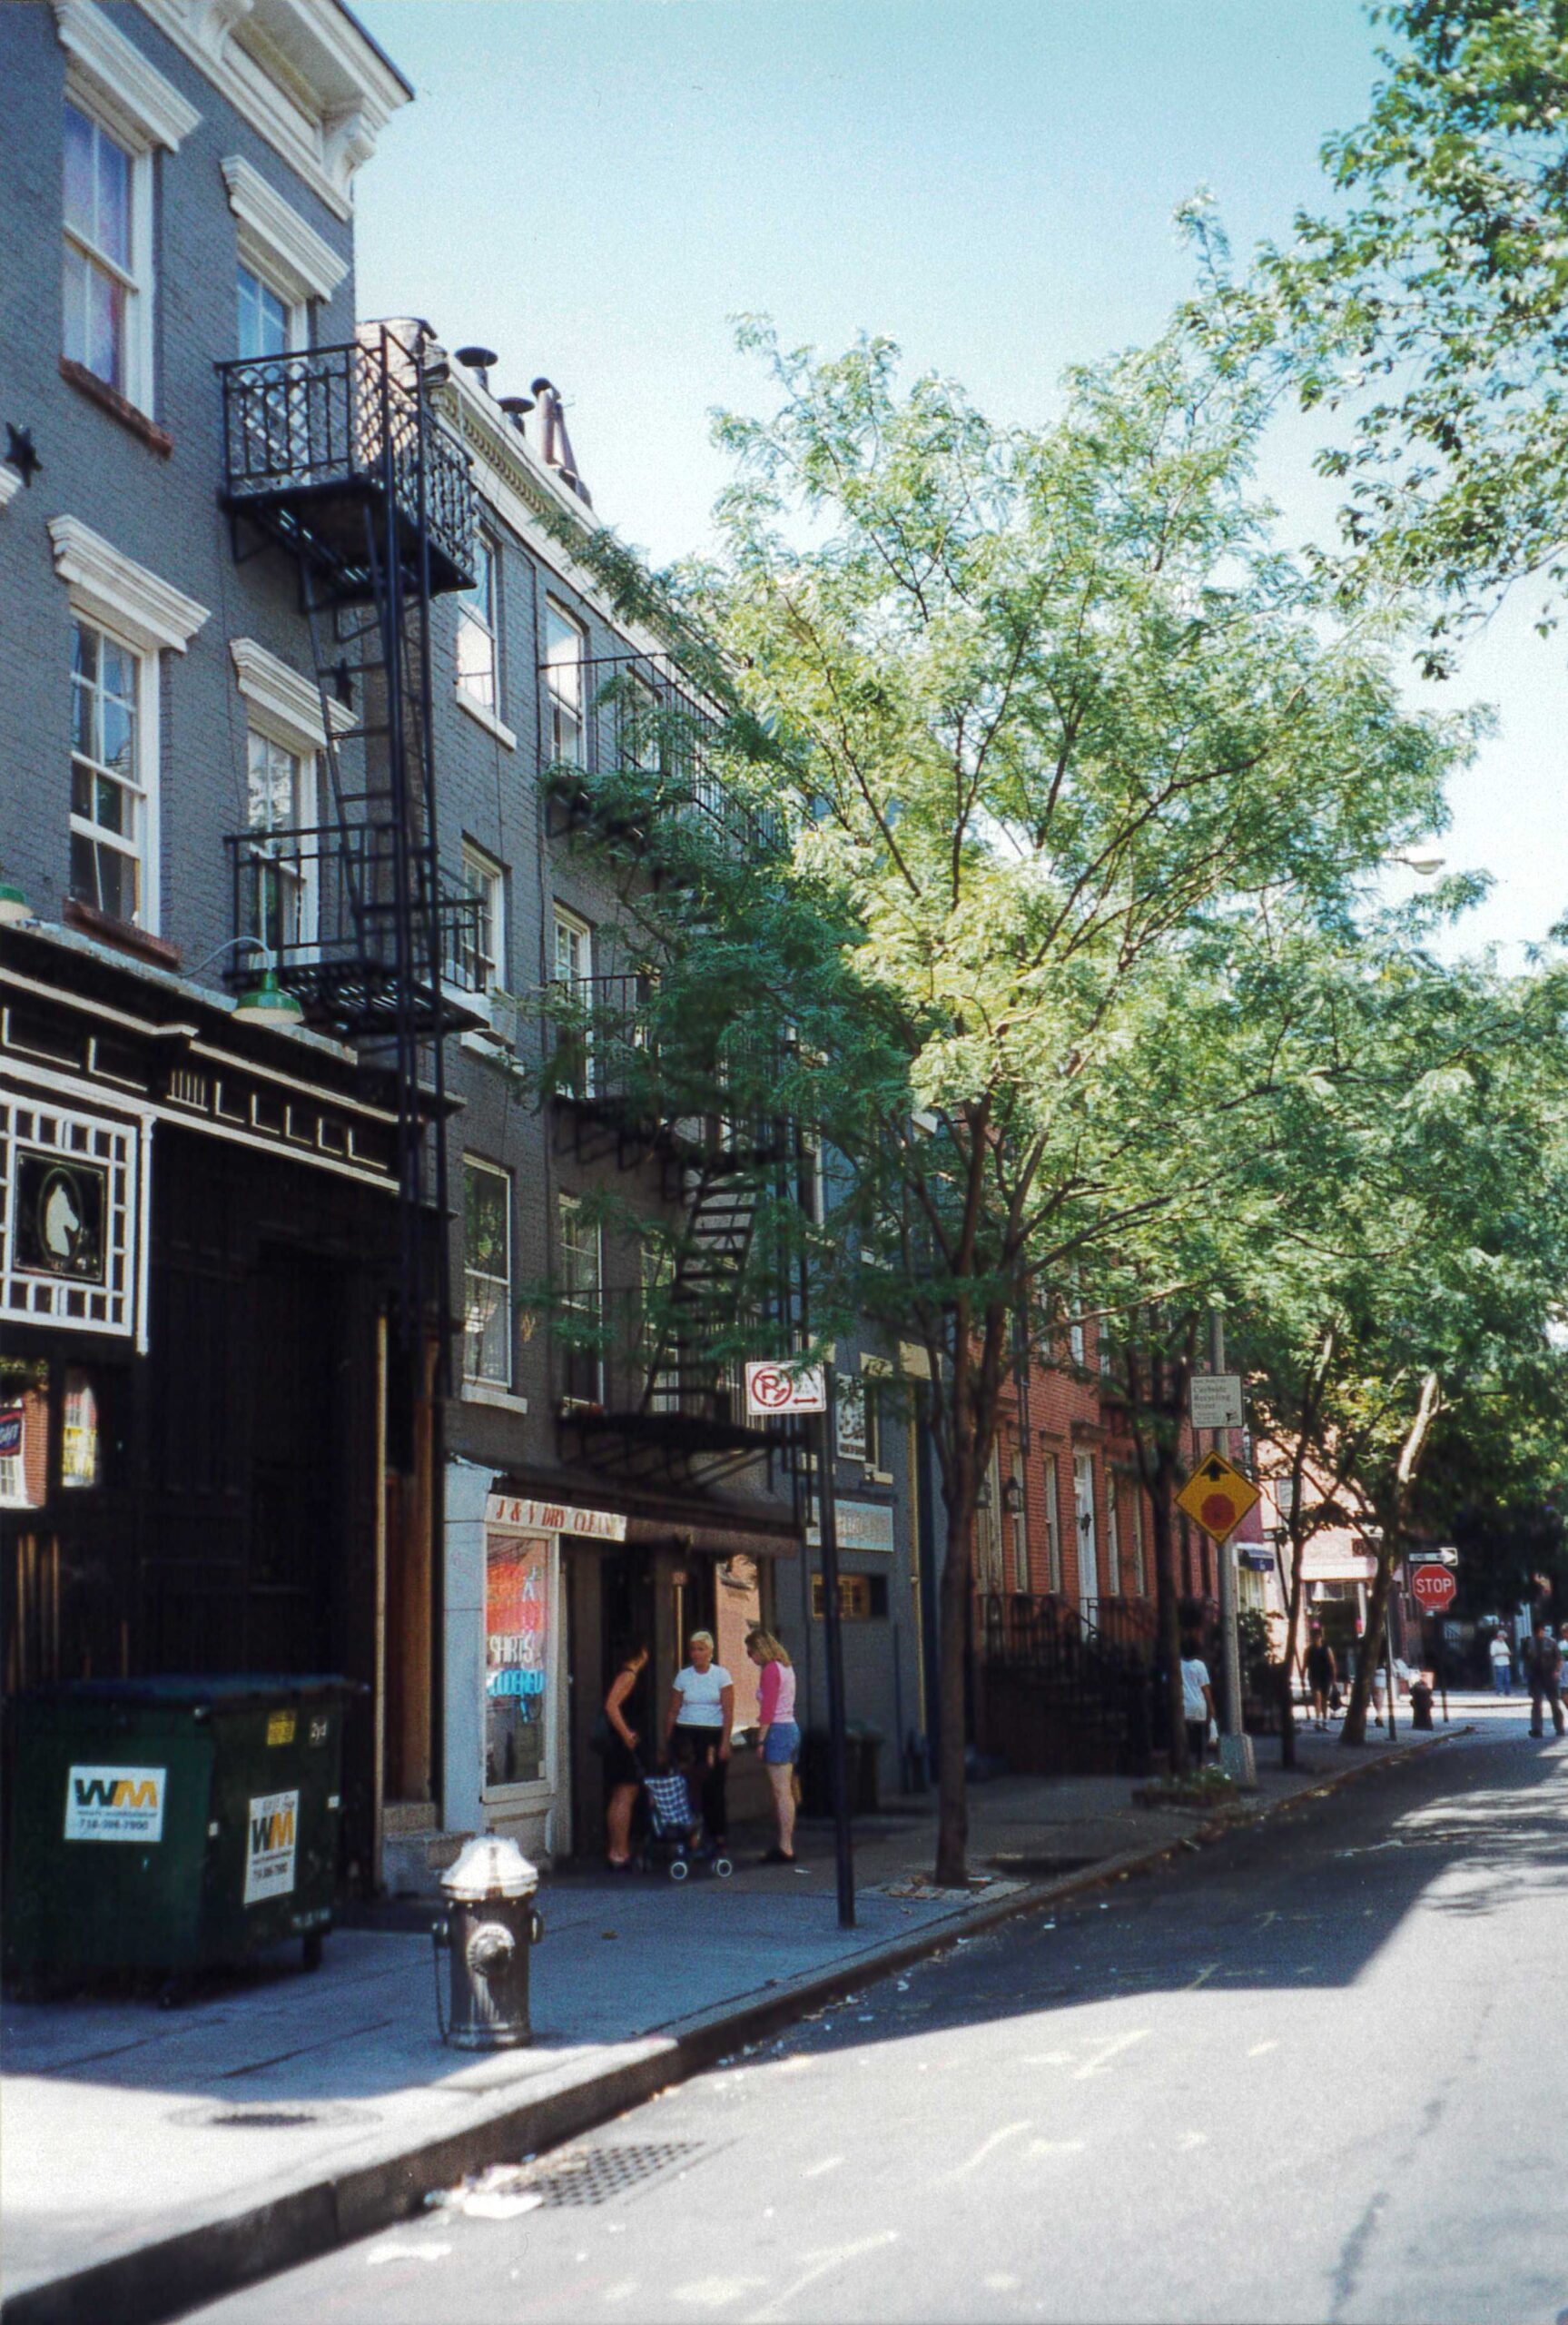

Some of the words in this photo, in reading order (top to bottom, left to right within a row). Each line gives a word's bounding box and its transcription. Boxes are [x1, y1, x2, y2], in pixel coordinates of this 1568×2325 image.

[496, 1499, 505, 1520] J
[510, 1501, 522, 1522] &
[541, 1507, 566, 1529] DRY
[1415, 1578, 1453, 1594] STOP
[488, 1634, 536, 1665] SHIRTS
[74, 1778, 158, 1808] WM
[251, 1809, 294, 1855] WM
